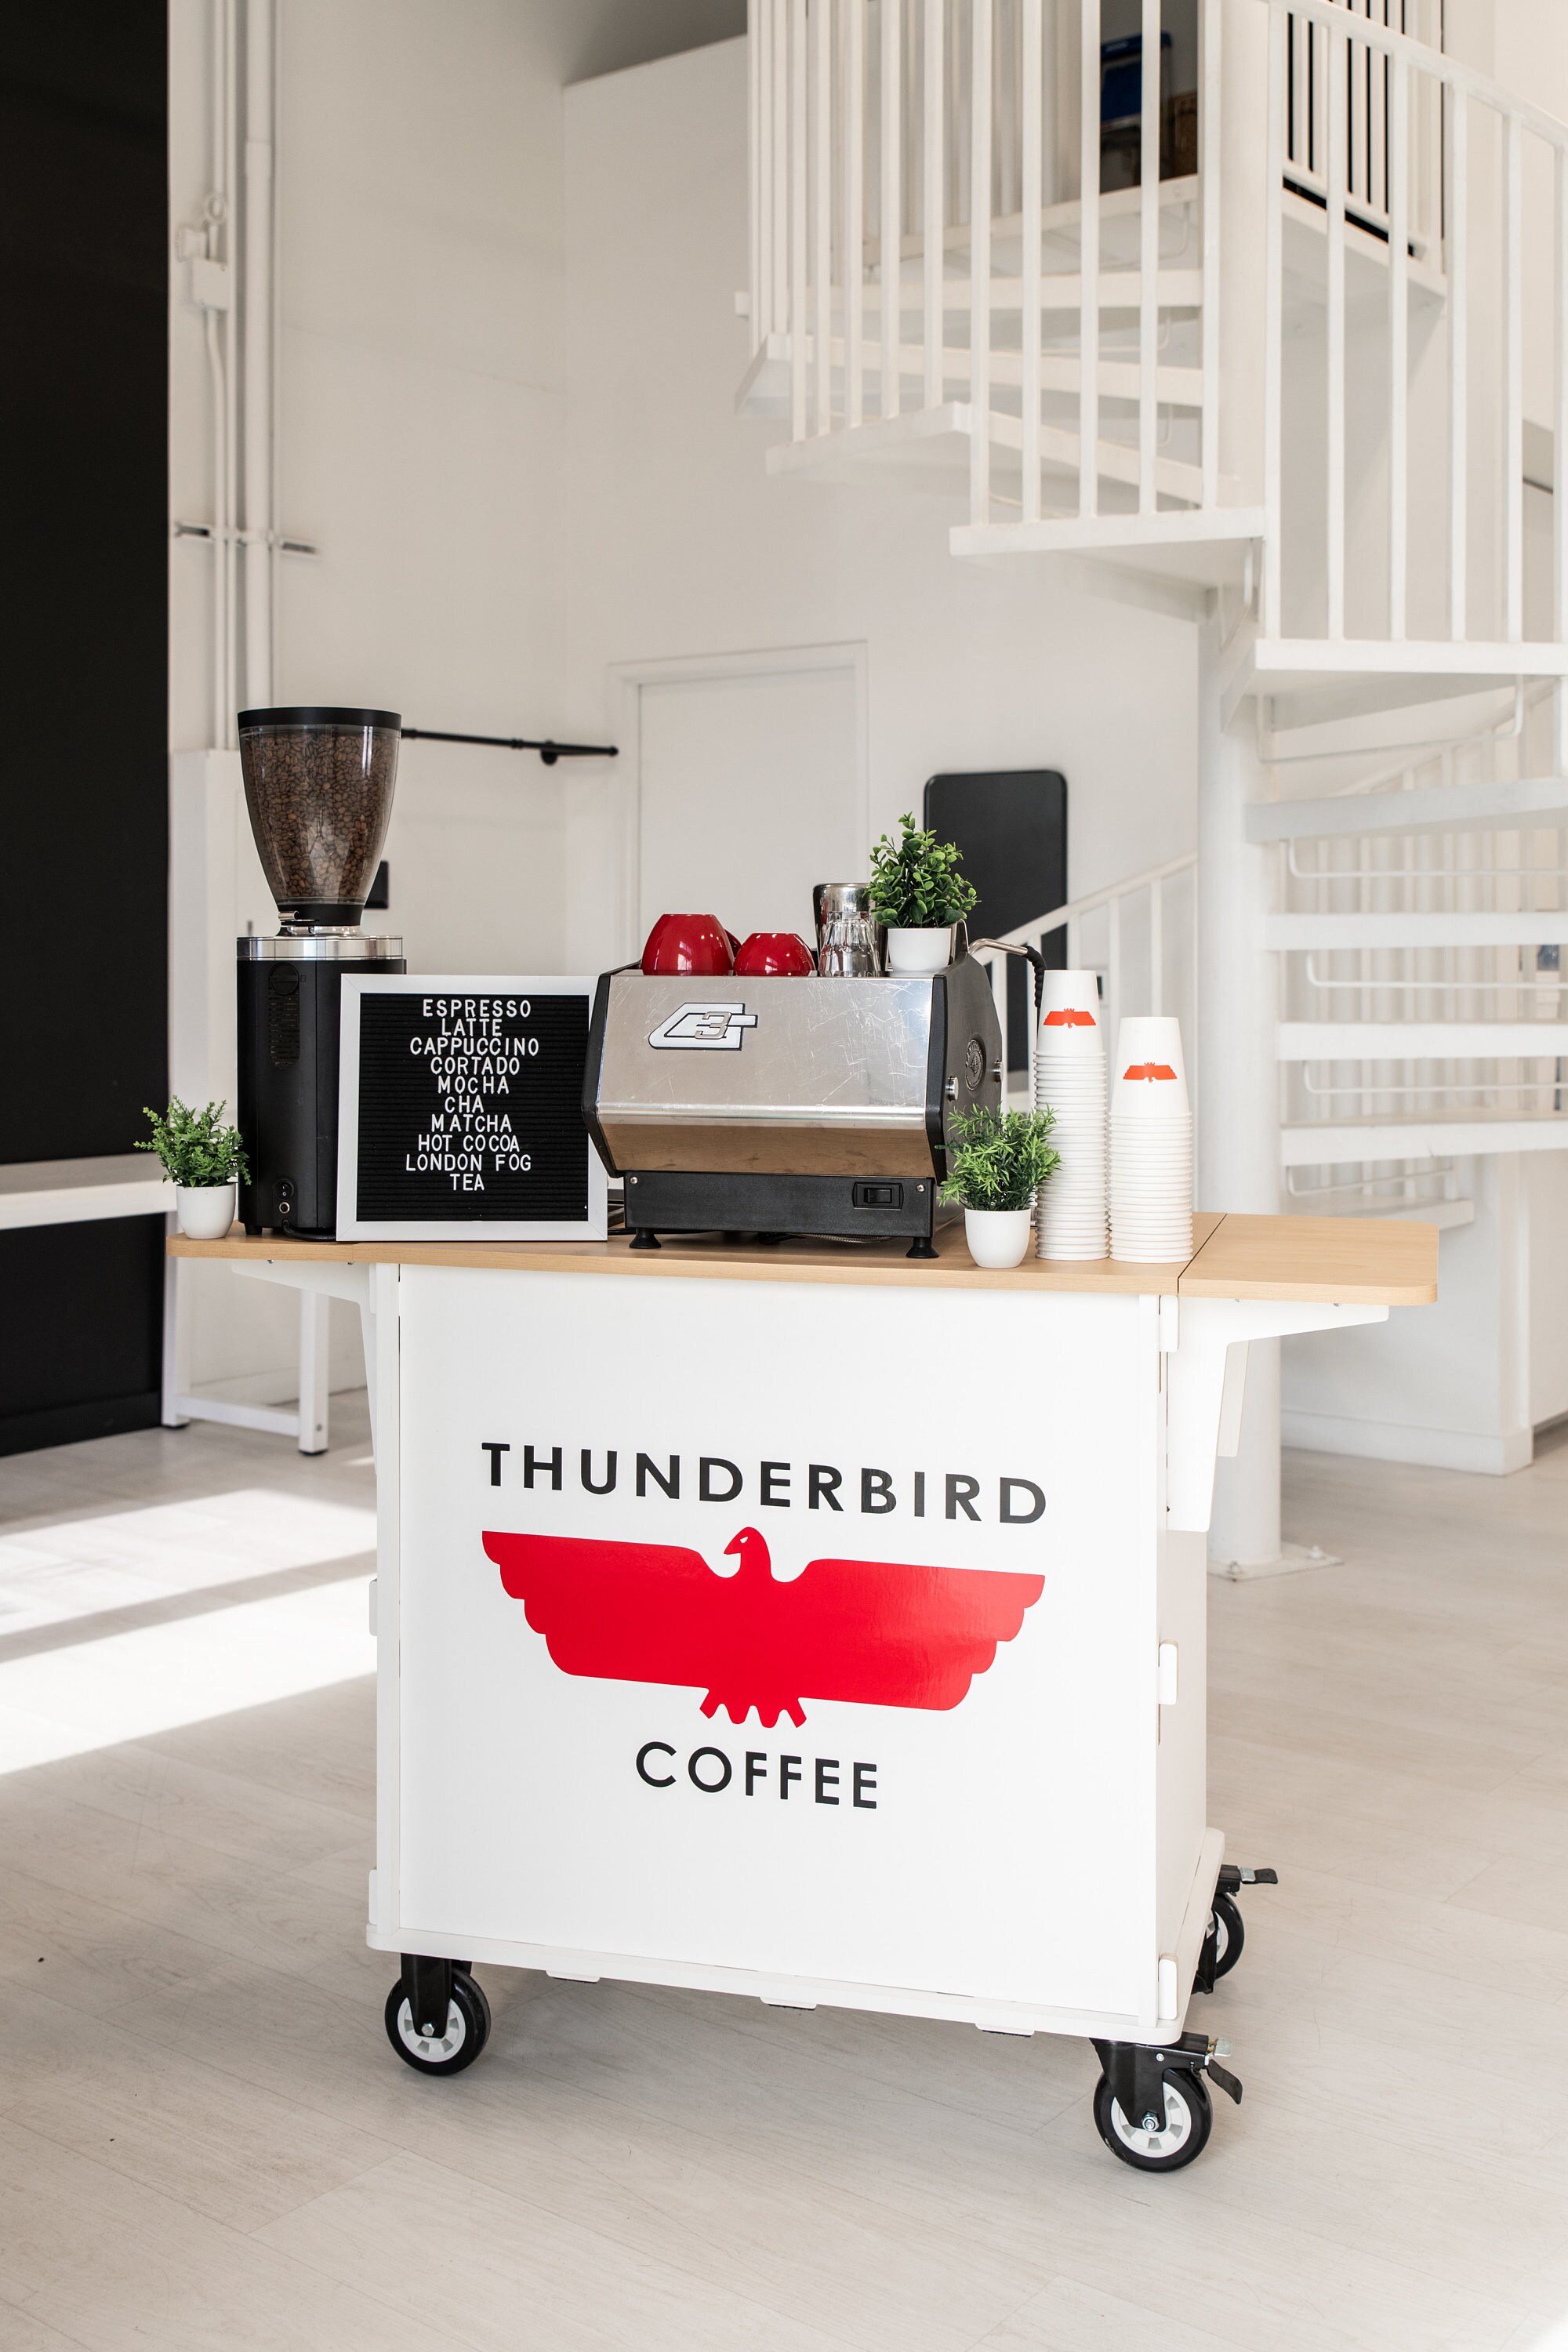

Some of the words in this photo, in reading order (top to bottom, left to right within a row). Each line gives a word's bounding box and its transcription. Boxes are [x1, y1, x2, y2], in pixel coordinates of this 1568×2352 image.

[423, 999, 532, 1018] ESPRESSO
[441, 1018, 503, 1036] LATTE
[409, 1037, 539, 1056] CAPPUCCINO
[430, 1057, 520, 1075] CORTADO
[437, 1076, 510, 1094] MOCHA
[445, 1095, 485, 1113] CHA
[431, 1114, 512, 1132] MATCHA
[418, 1134, 452, 1152] HOT
[463, 1134, 520, 1152] COCOA
[405, 1153, 482, 1171] LONDON
[495, 1154, 532, 1171] FOG
[449, 1174, 485, 1191] TEA
[481, 1442, 1046, 1524] THUNDERBIRD
[636, 1741, 877, 1809] COFFEE
